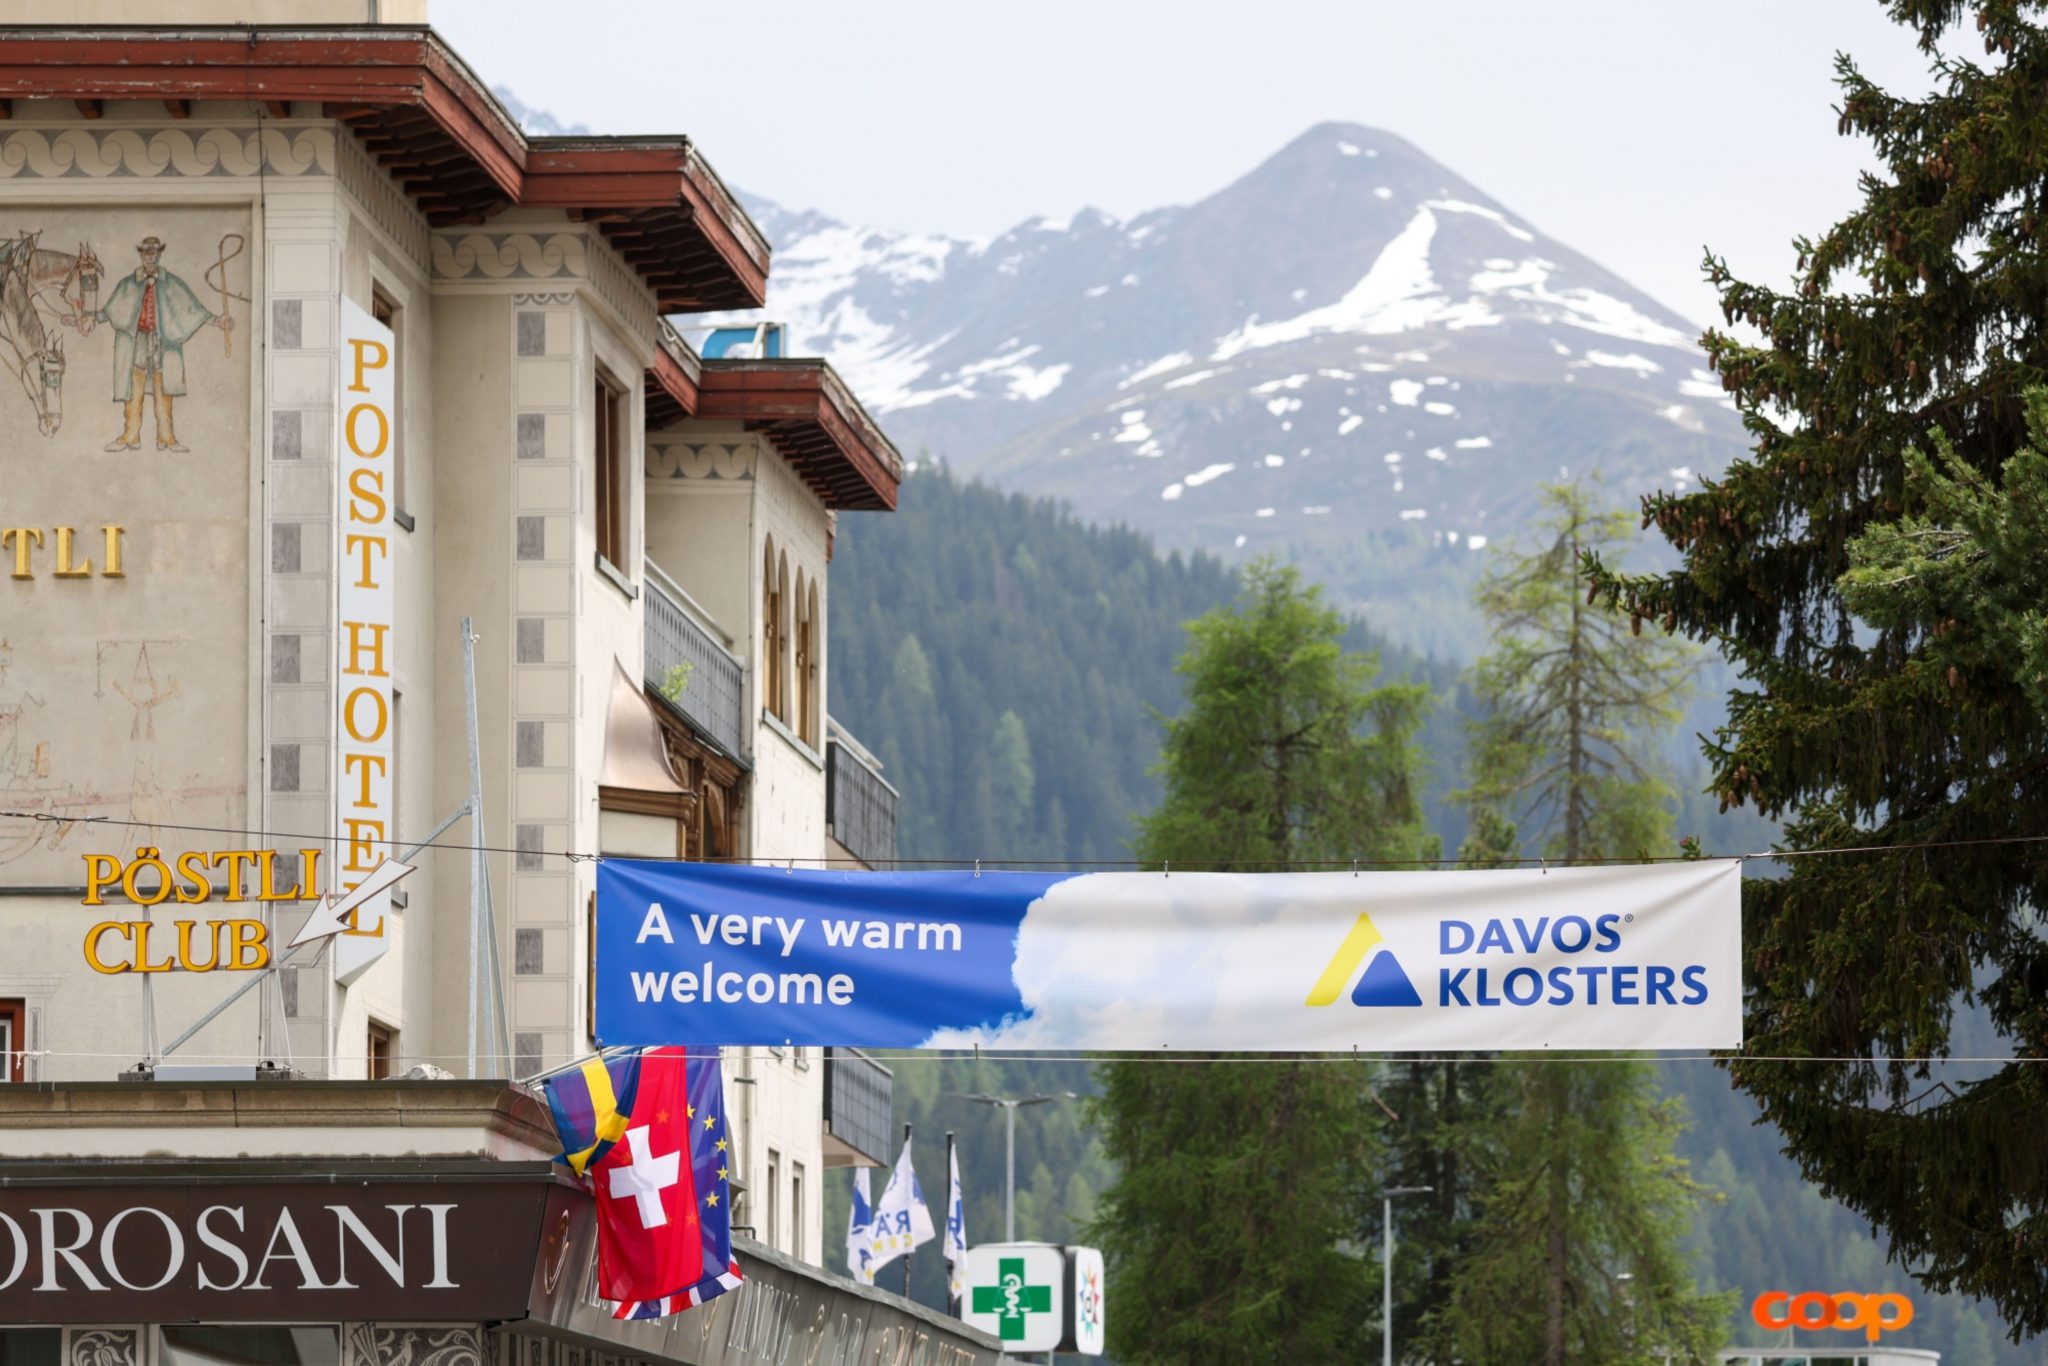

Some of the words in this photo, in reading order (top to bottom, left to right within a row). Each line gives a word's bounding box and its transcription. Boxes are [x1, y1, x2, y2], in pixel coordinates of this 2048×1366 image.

[345, 338, 389, 589] POST
[2, 526, 125, 581] TLI
[81, 846, 322, 906] PÖSTLI
[83, 917, 272, 975] CLUB
[636, 903, 674, 944] A
[690, 914, 804, 957] very
[821, 919, 962, 951] warm
[630, 961, 855, 1006] welcome
[1439, 964, 1709, 1007] KLOSTERS
[1752, 1291, 1914, 1342] coop
